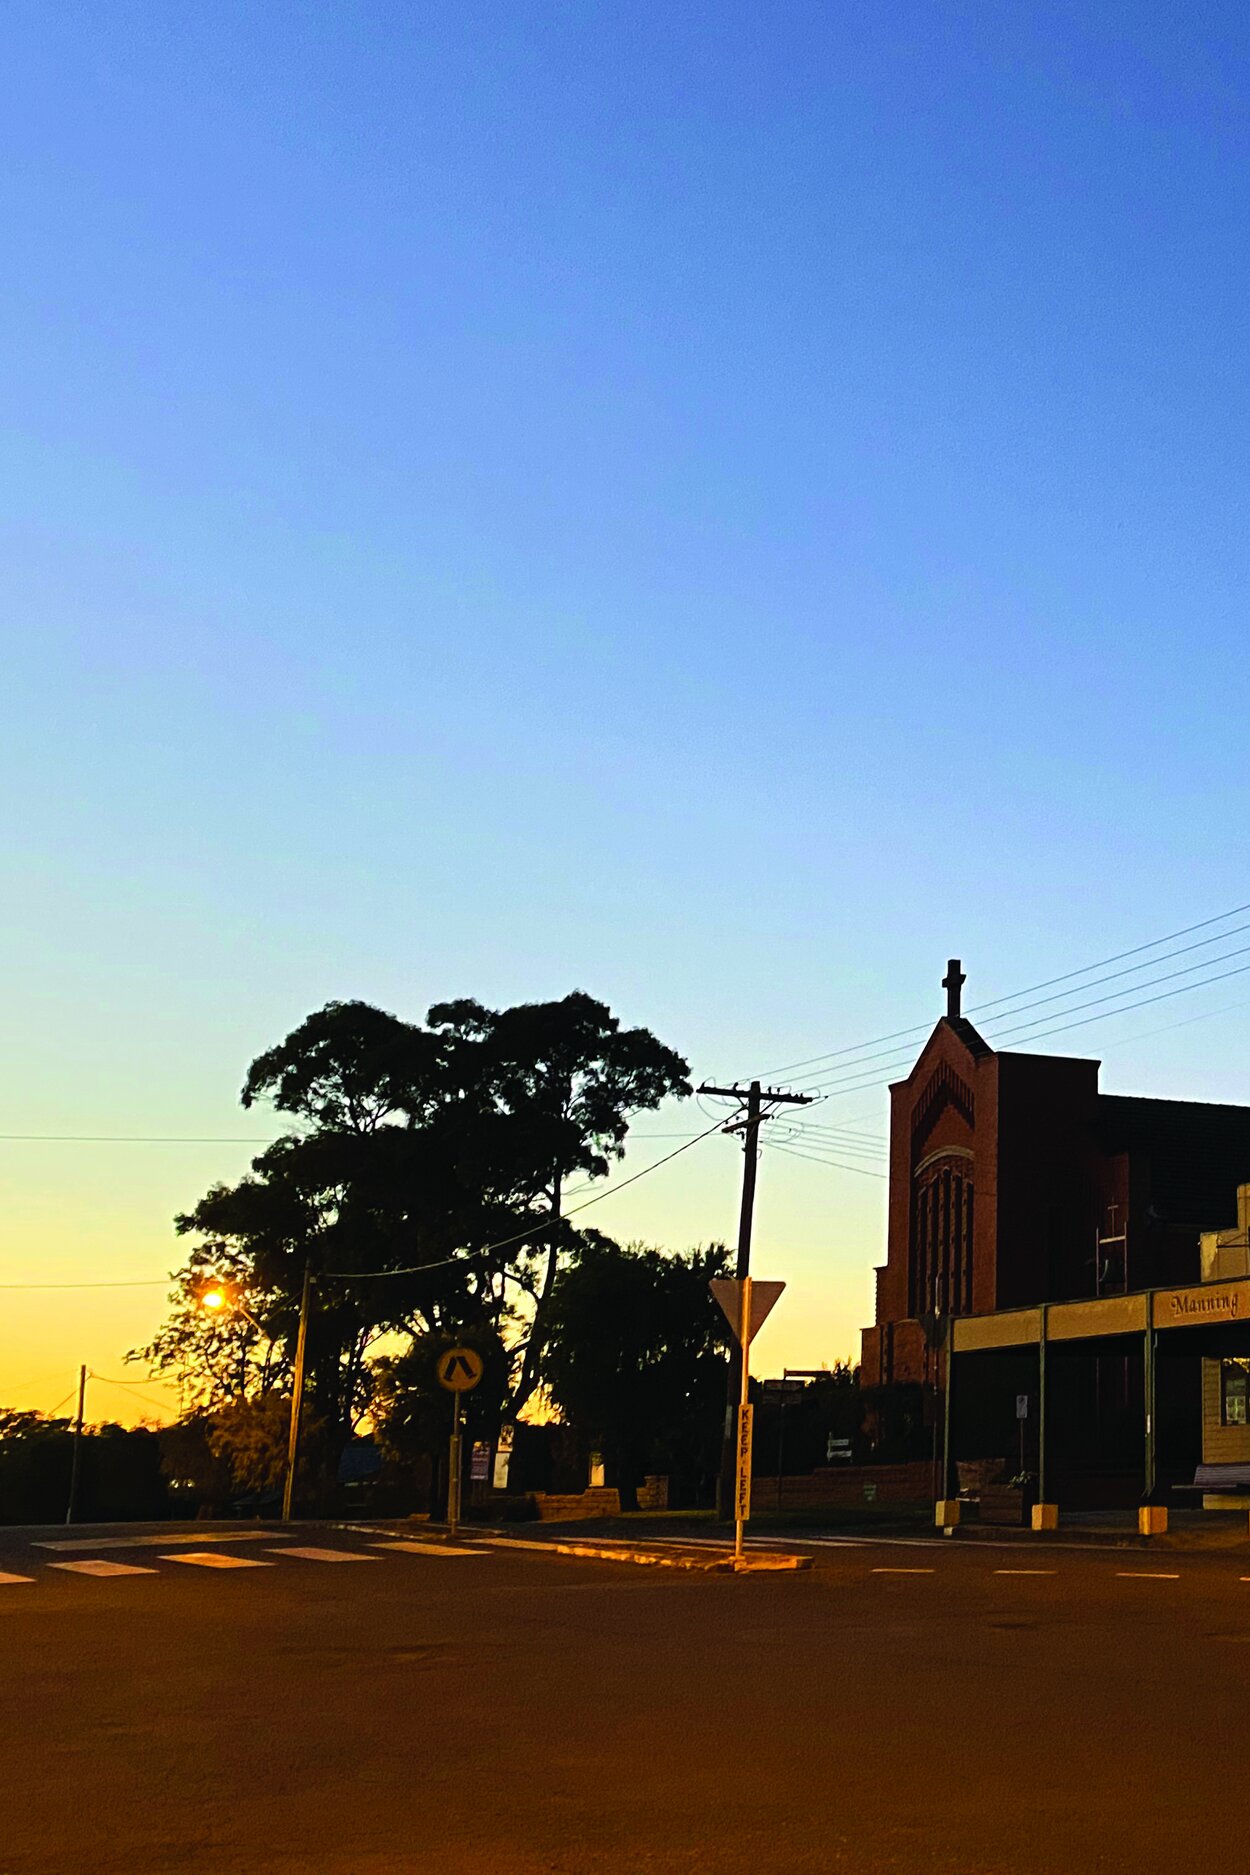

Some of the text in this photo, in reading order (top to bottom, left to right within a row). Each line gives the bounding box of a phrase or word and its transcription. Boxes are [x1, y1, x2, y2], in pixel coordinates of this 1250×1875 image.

[1171, 1291, 1239, 1317] Manning
[739, 1409, 749, 1517] KEEP LEFT
